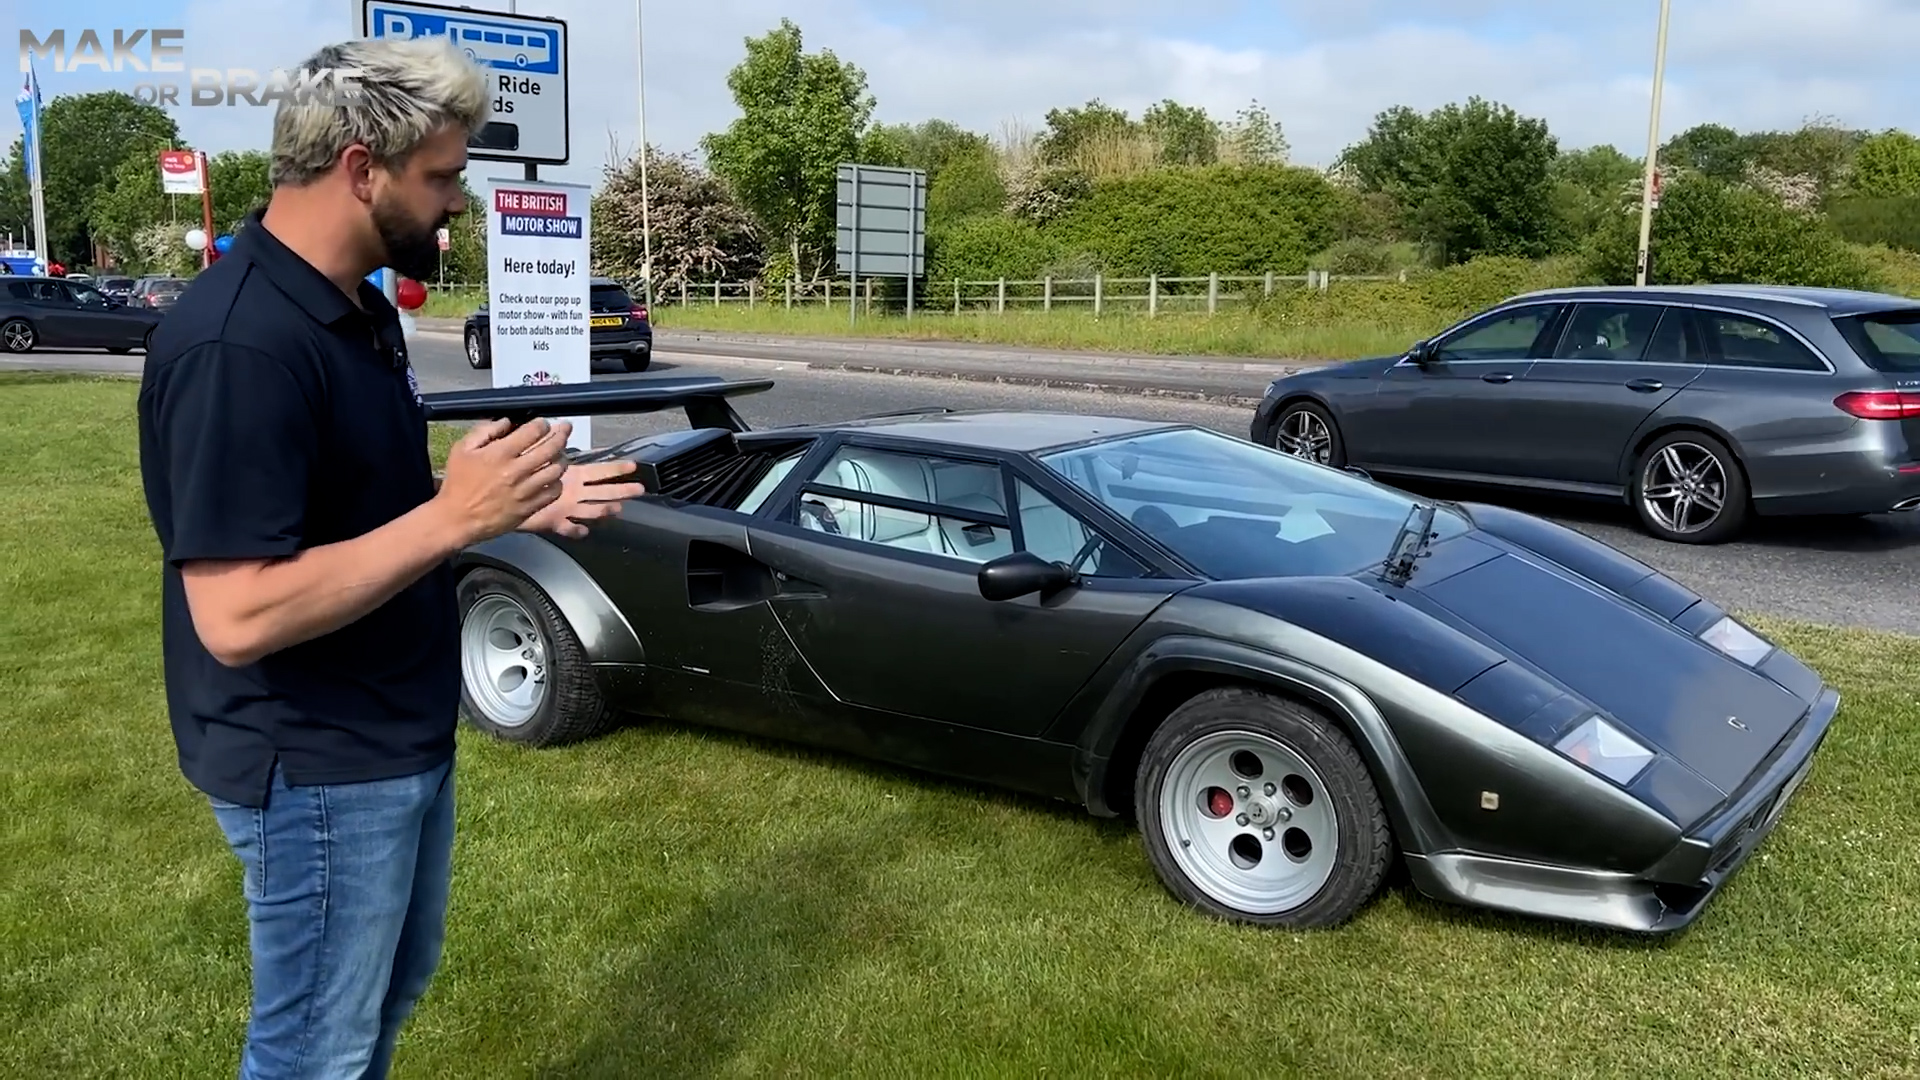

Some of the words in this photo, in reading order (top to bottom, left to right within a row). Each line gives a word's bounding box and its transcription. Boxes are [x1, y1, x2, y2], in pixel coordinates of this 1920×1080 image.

[499, 75, 541, 95] Ride
[498, 193, 519, 209] THE
[521, 195, 564, 211] BRITISH
[505, 216, 544, 232] MOTOR
[546, 219, 578, 234] SHOW
[504, 257, 533, 273] Here
[537, 259, 575, 278] today!
[499, 293, 523, 304] Check
[524, 295, 538, 304] out
[540, 296, 553, 304] our
[554, 296, 569, 306] pop
[571, 297, 581, 306] up
[498, 310, 522, 320] motor
[523, 310, 545, 320] show
[551, 310, 568, 320] with
[569, 310, 583, 320] fun
[497, 325, 508, 335] for
[510, 325, 527, 335] both
[529, 325, 553, 335] adults
[555, 326, 569, 335] and
[571, 326, 584, 336] the
[533, 340, 550, 351] kids
